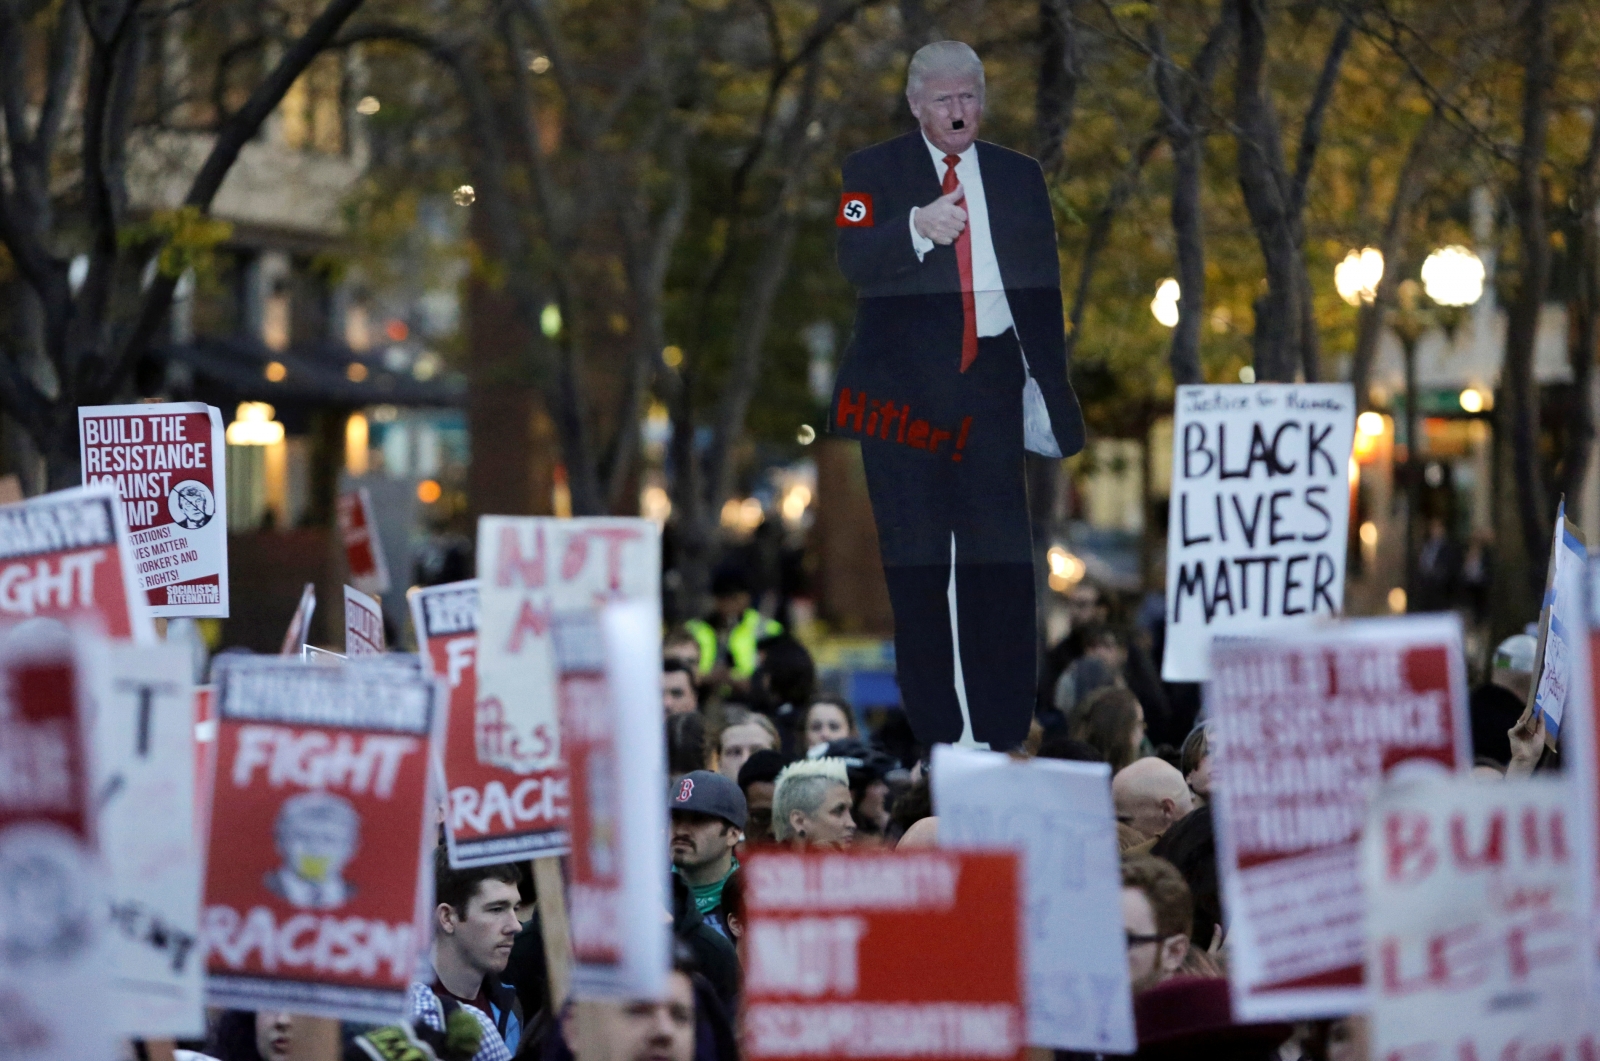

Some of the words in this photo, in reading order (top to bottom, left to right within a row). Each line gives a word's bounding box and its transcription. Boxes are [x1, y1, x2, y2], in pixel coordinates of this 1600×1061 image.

[86, 418, 144, 445] BUILD
[149, 416, 187, 442] THE
[836, 387, 973, 462] Hitler!
[87, 443, 206, 473] RESISTANCE
[1184, 421, 1337, 480] BLACK
[1180, 487, 1332, 548] LIVES
[151, 538, 188, 556] MATTER!
[180, 549, 198, 564] AND
[146, 569, 180, 588] RIGHTS!
[166, 585, 208, 595] SOCIALIST
[1173, 554, 1336, 624] MATTER
[167, 593, 220, 604] ALTERNATIVE
[231, 724, 417, 798] FIGHT
[676, 778, 694, 802] B
[202, 904, 413, 980] RACISM
[742, 915, 870, 997] NOT
